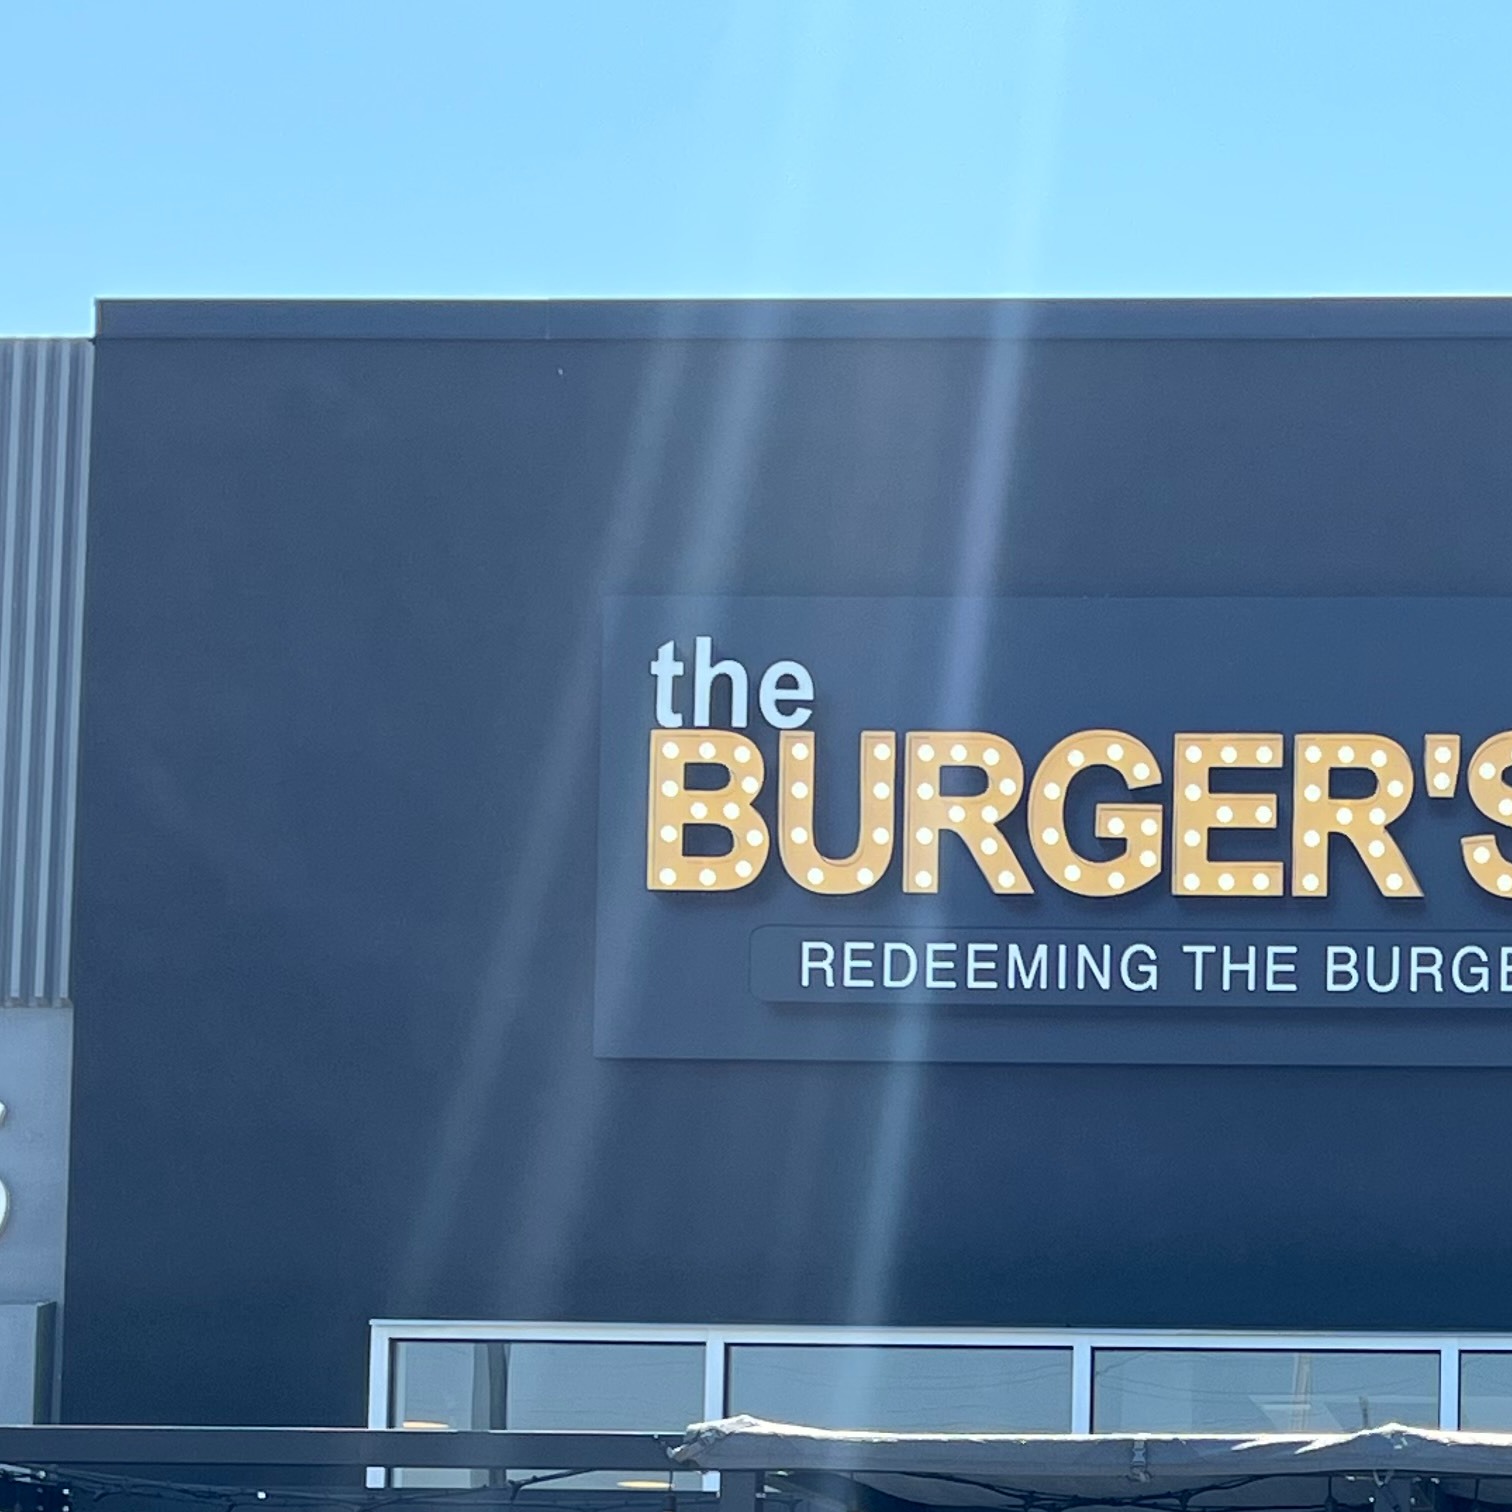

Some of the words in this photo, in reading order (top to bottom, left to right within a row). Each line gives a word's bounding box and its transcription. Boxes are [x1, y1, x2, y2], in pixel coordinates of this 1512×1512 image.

[650, 636, 814, 729] the
[800, 940, 1159, 991] REDEEMING
[1181, 944, 1298, 992] THE
